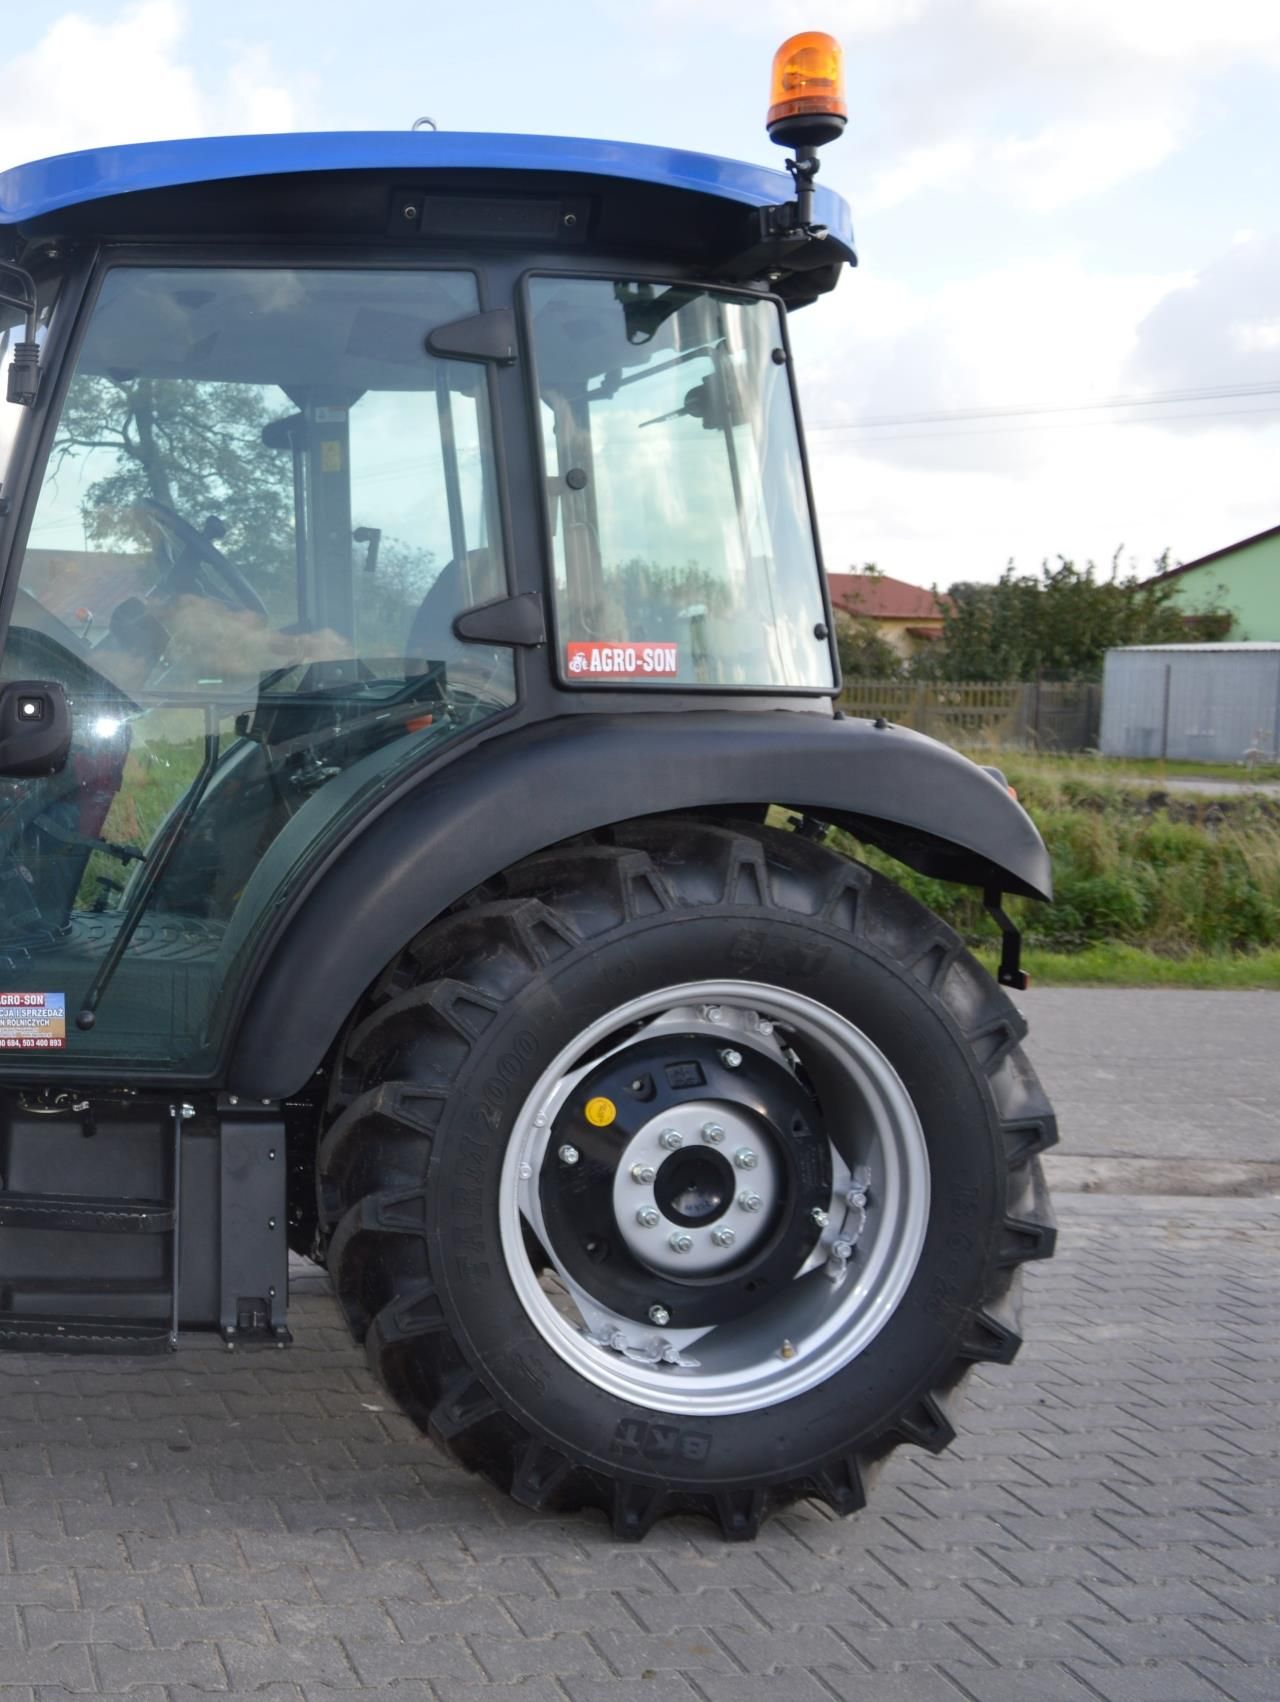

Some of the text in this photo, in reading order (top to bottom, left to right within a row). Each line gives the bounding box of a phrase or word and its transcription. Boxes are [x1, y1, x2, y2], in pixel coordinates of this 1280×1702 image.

[591, 647, 677, 673] AGRO-SON
[21, 1008, 64, 1017] SPRZEDAŻ
[7, 1019, 50, 1027] ROLNICZYCH
[22, 1039, 35, 1047] 503
[36, 1039, 48, 1047] 400
[469, 1030, 540, 1132] 2000
